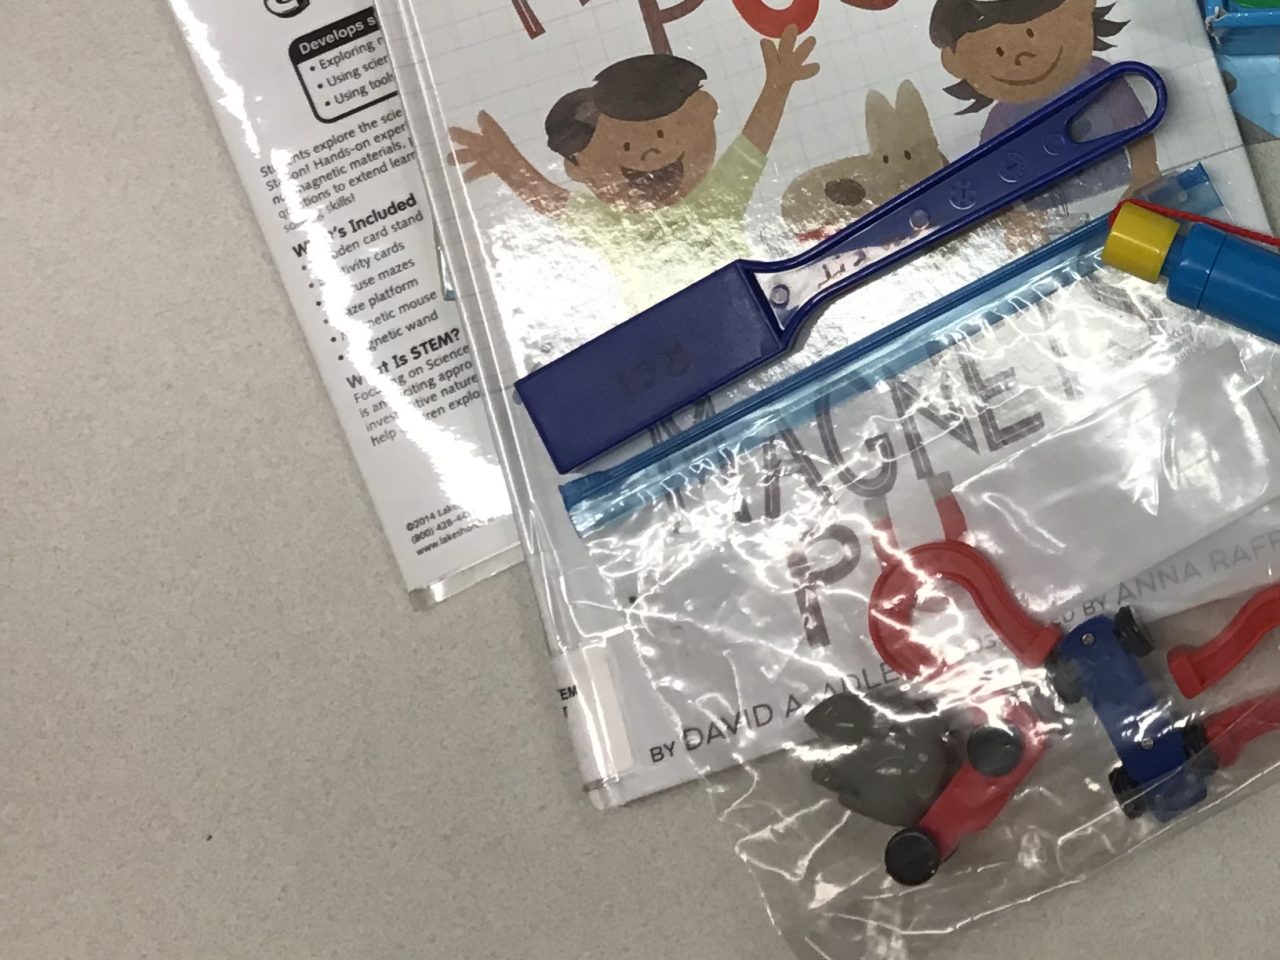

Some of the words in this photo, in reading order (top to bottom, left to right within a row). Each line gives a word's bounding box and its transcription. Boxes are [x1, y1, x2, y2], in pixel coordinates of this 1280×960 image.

[299, 19, 365, 55] Develops
[319, 41, 375, 73] Exploring
[326, 66, 361, 89] Using
[334, 86, 367, 109] Using
[313, 129, 356, 154] explore
[358, 120, 378, 134] the
[313, 139, 371, 170] Hands-on
[333, 182, 346, 195] to
[348, 162, 388, 187] extend
[326, 193, 356, 213] skills!
[348, 192, 417, 233] Included
[363, 226, 388, 245] card
[391, 211, 423, 232] stand
[374, 241, 405, 262] cards
[378, 258, 416, 280] mazes
[368, 278, 419, 310] platform
[398, 291, 438, 314] mouse
[405, 310, 439, 332] wand
[392, 354, 408, 369] Is
[410, 328, 460, 360] STEM?
[408, 366, 424, 379] on
[426, 344, 470, 370] Science
[359, 407, 370, 418] is
[372, 400, 388, 413] an
[438, 360, 473, 384] appro
[440, 374, 479, 397] nature
[370, 429, 397, 447] help
[448, 390, 480, 410] explo
[1082, 598, 1107, 617] BY
[1116, 561, 1201, 605] ANNA
[650, 741, 676, 763] BY
[684, 702, 774, 751] DAVID
[822, 660, 902, 694] ADLE
